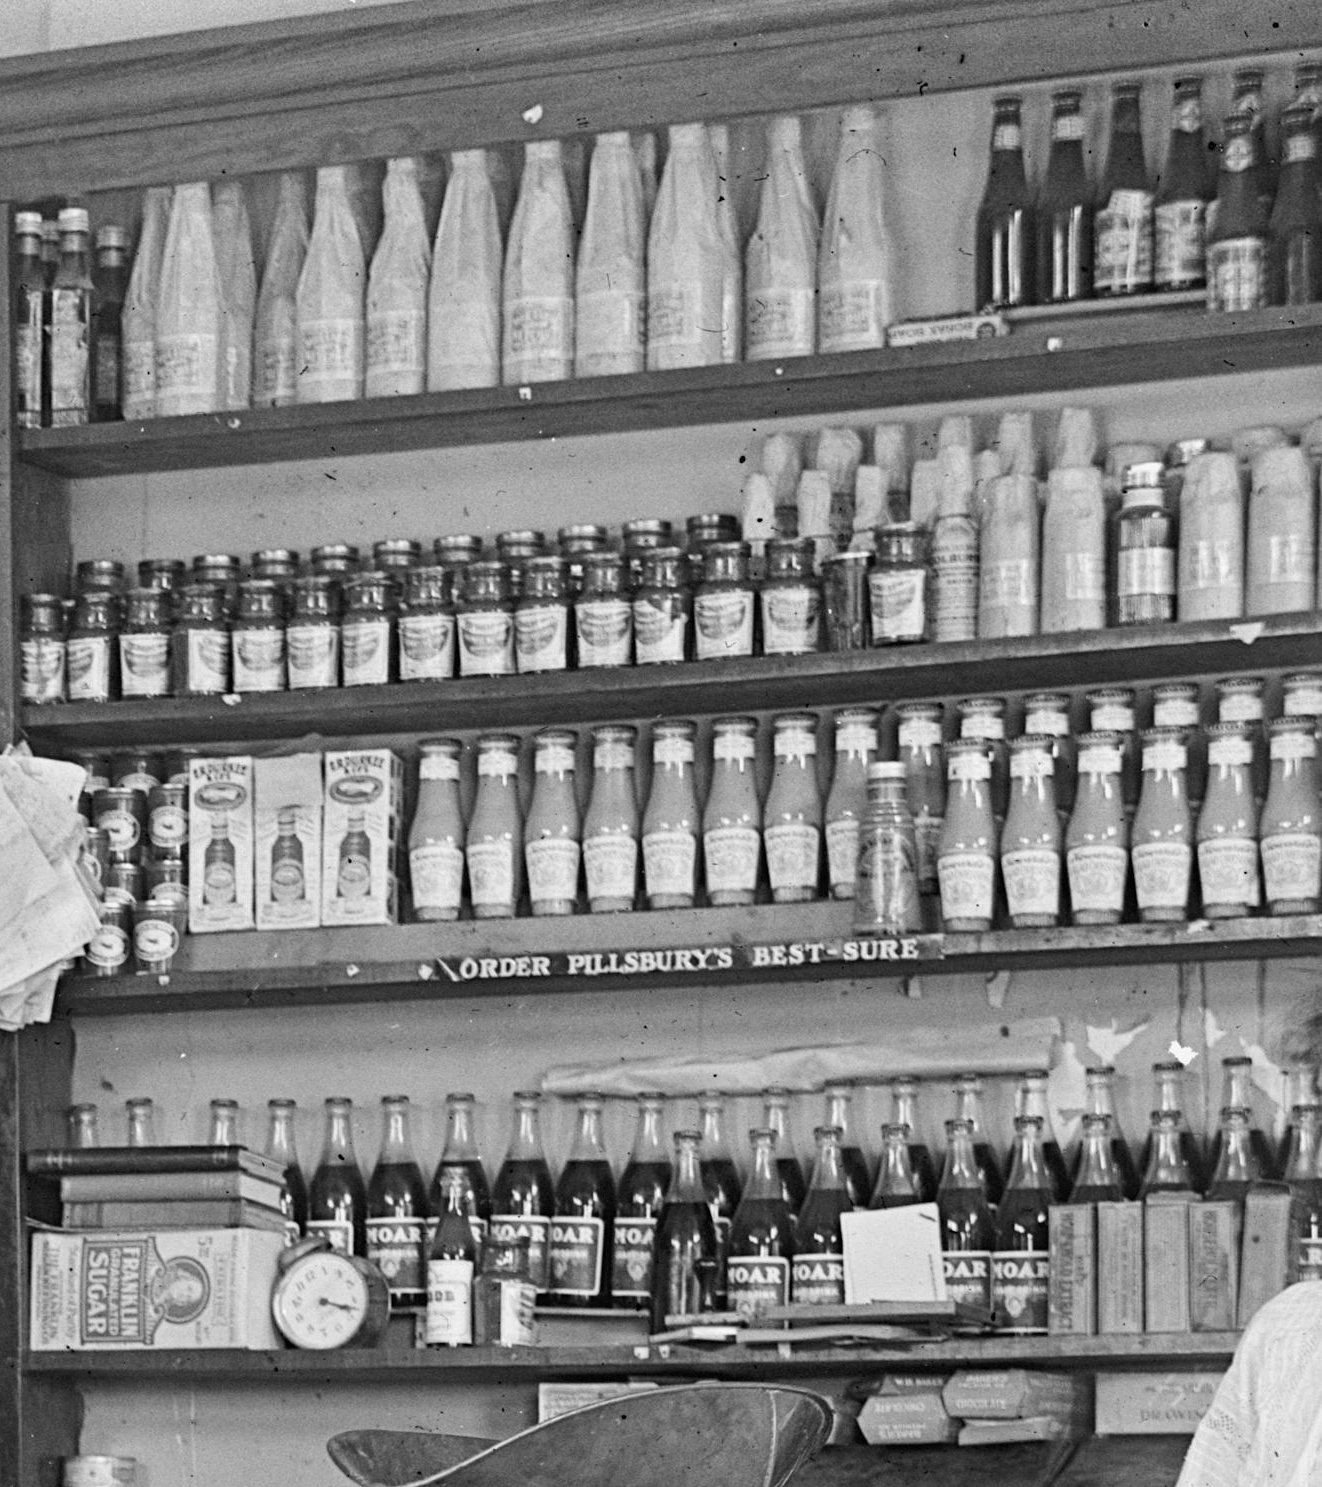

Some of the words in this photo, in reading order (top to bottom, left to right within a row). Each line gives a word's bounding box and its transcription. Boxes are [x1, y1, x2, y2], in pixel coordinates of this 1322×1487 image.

[459, 956, 551, 980] ORDER
[567, 947, 733, 976] PILLSBURY'S
[86, 1250, 108, 1335] SUGAR
[108, 1247, 122, 1337] GRANULATED
[121, 1246, 141, 1338] FRANKLIN
